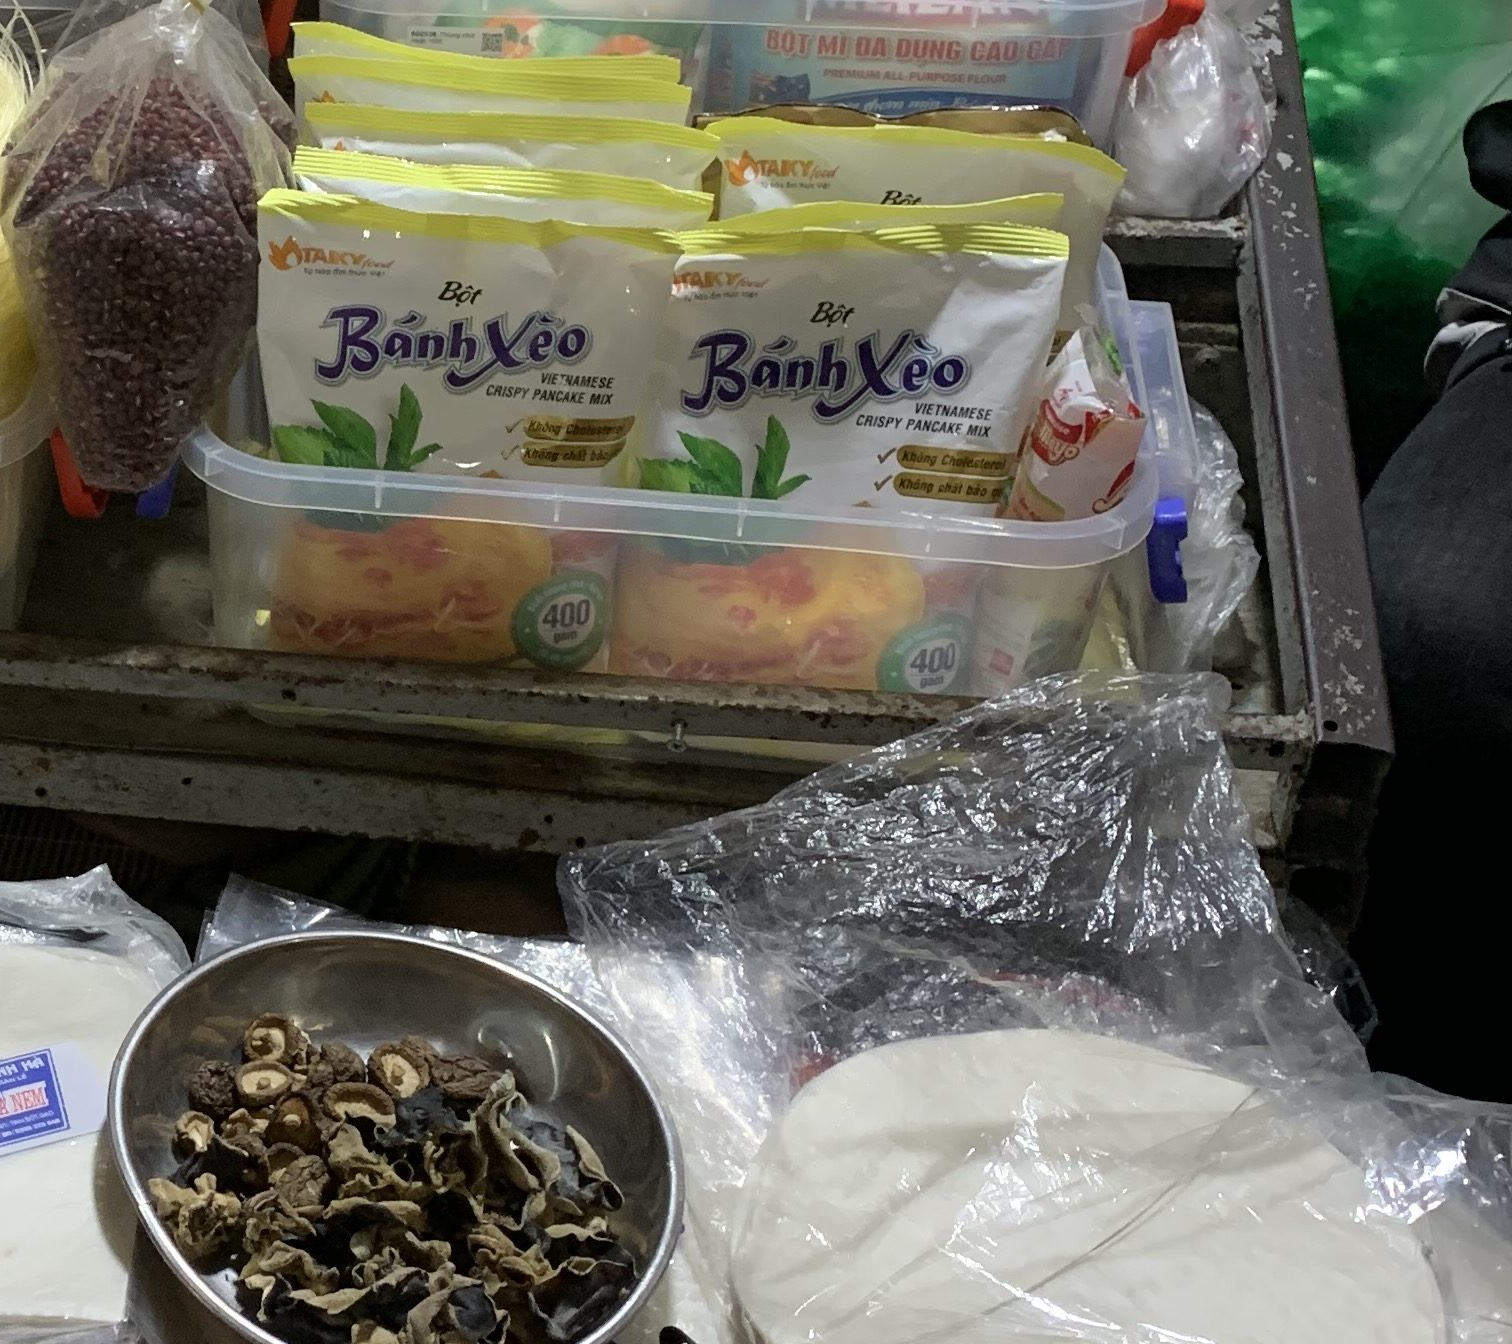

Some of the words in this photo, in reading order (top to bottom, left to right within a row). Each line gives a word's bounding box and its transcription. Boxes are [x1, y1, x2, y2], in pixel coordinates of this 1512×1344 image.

[438, 281, 482, 307] Bột
[810, 301, 855, 327] Bột
[314, 303, 484, 386] Bánh
[540, 371, 615, 390] VIETNAMESE
[682, 330, 847, 417] Bánh
[813, 329, 972, 424] Xèo
[485, 383, 529, 401] CRISPY
[531, 387, 585, 405] PANCAKE
[588, 392, 614, 406] MIX
[915, 402, 993, 421] VIETNAMESE
[856, 413, 901, 430] CRISPY
[906, 417, 963, 436] PANCAKE
[966, 423, 992, 438] MIX
[543, 598, 592, 629] 400
[910, 642, 956, 674] 400
